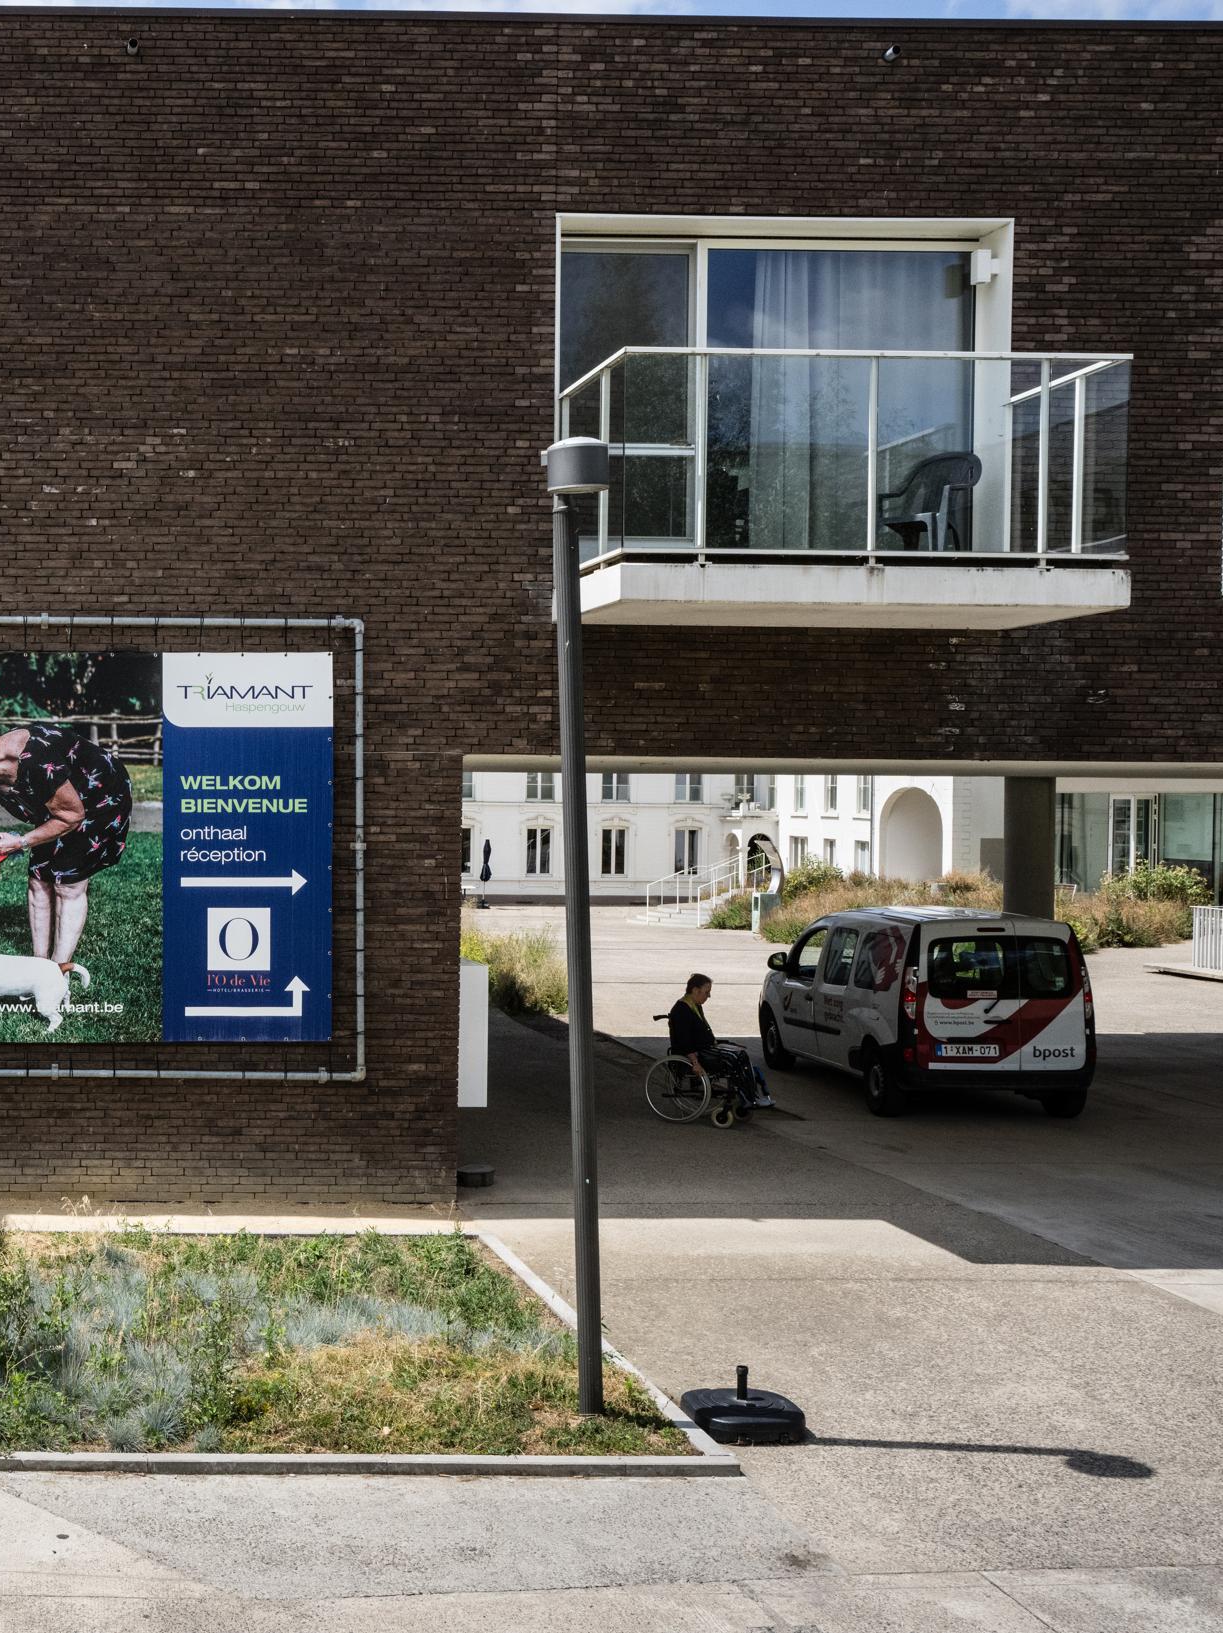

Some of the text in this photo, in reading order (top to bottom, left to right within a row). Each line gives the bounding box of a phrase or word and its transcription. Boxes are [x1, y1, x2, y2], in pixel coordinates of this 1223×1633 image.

[177, 684, 313, 700] TRIAMANT
[225, 702, 306, 714] Haspengouw
[180, 775, 281, 790] WELKOM
[181, 798, 308, 813] BIENVENUE
[180, 825, 247, 840] onthaal
[180, 846, 267, 865] réception
[219, 917, 259, 961] O
[230, 974, 246, 986] de
[250, 974, 271, 986] Vie
[1032, 1045, 1076, 1061] bpost
